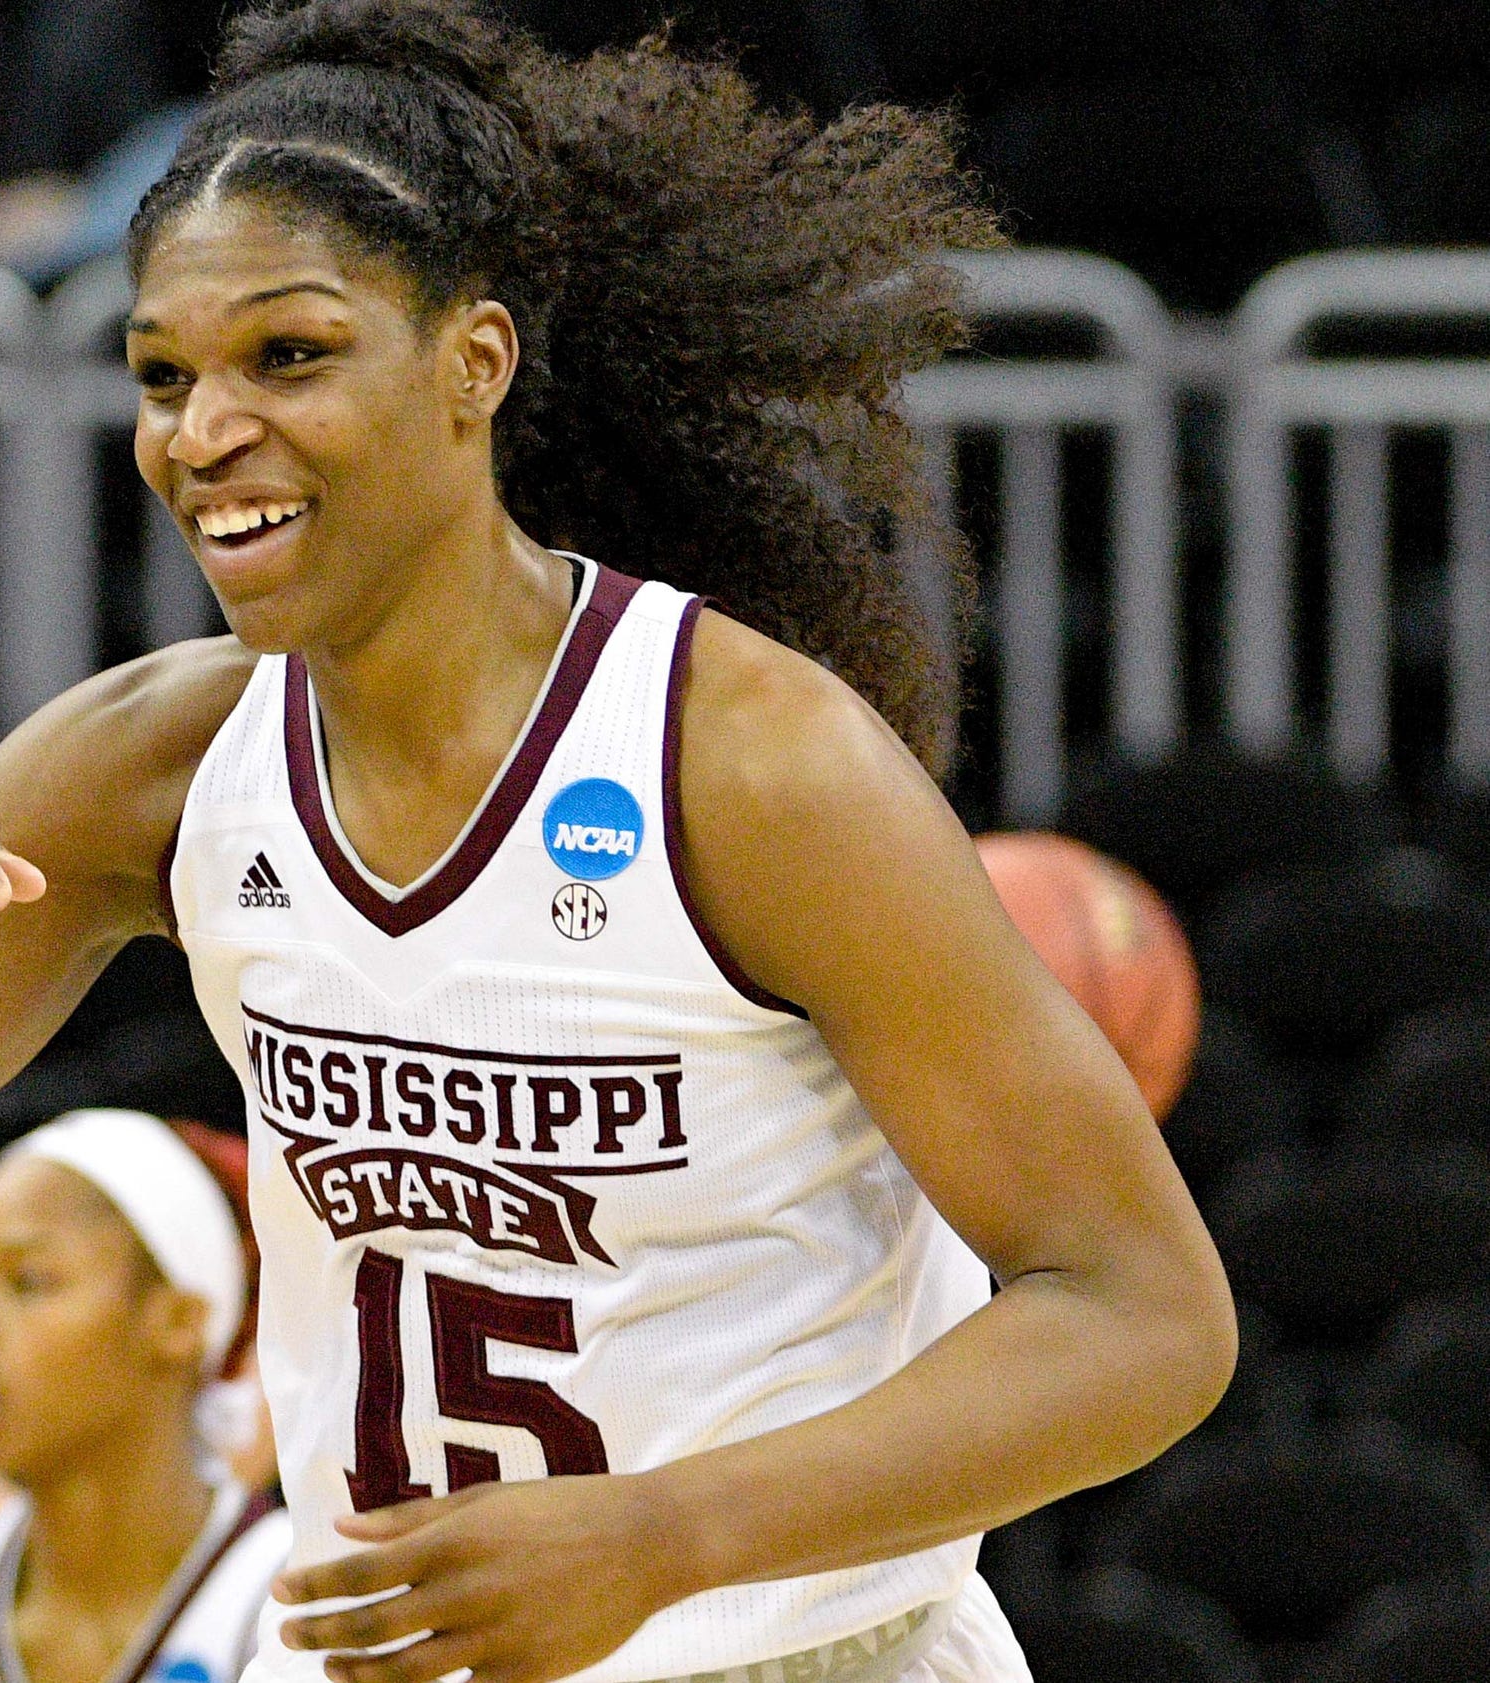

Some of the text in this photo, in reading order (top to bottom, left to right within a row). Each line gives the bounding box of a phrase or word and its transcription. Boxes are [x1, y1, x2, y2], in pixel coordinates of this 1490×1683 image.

[553, 822, 636, 857] NCAA
[238, 887, 291, 909] adidas
[553, 884, 608, 940] SEC
[243, 1019, 688, 1155] MISSISSIPPI
[321, 1160, 541, 1250] STATE
[344, 1247, 609, 1514] 15
